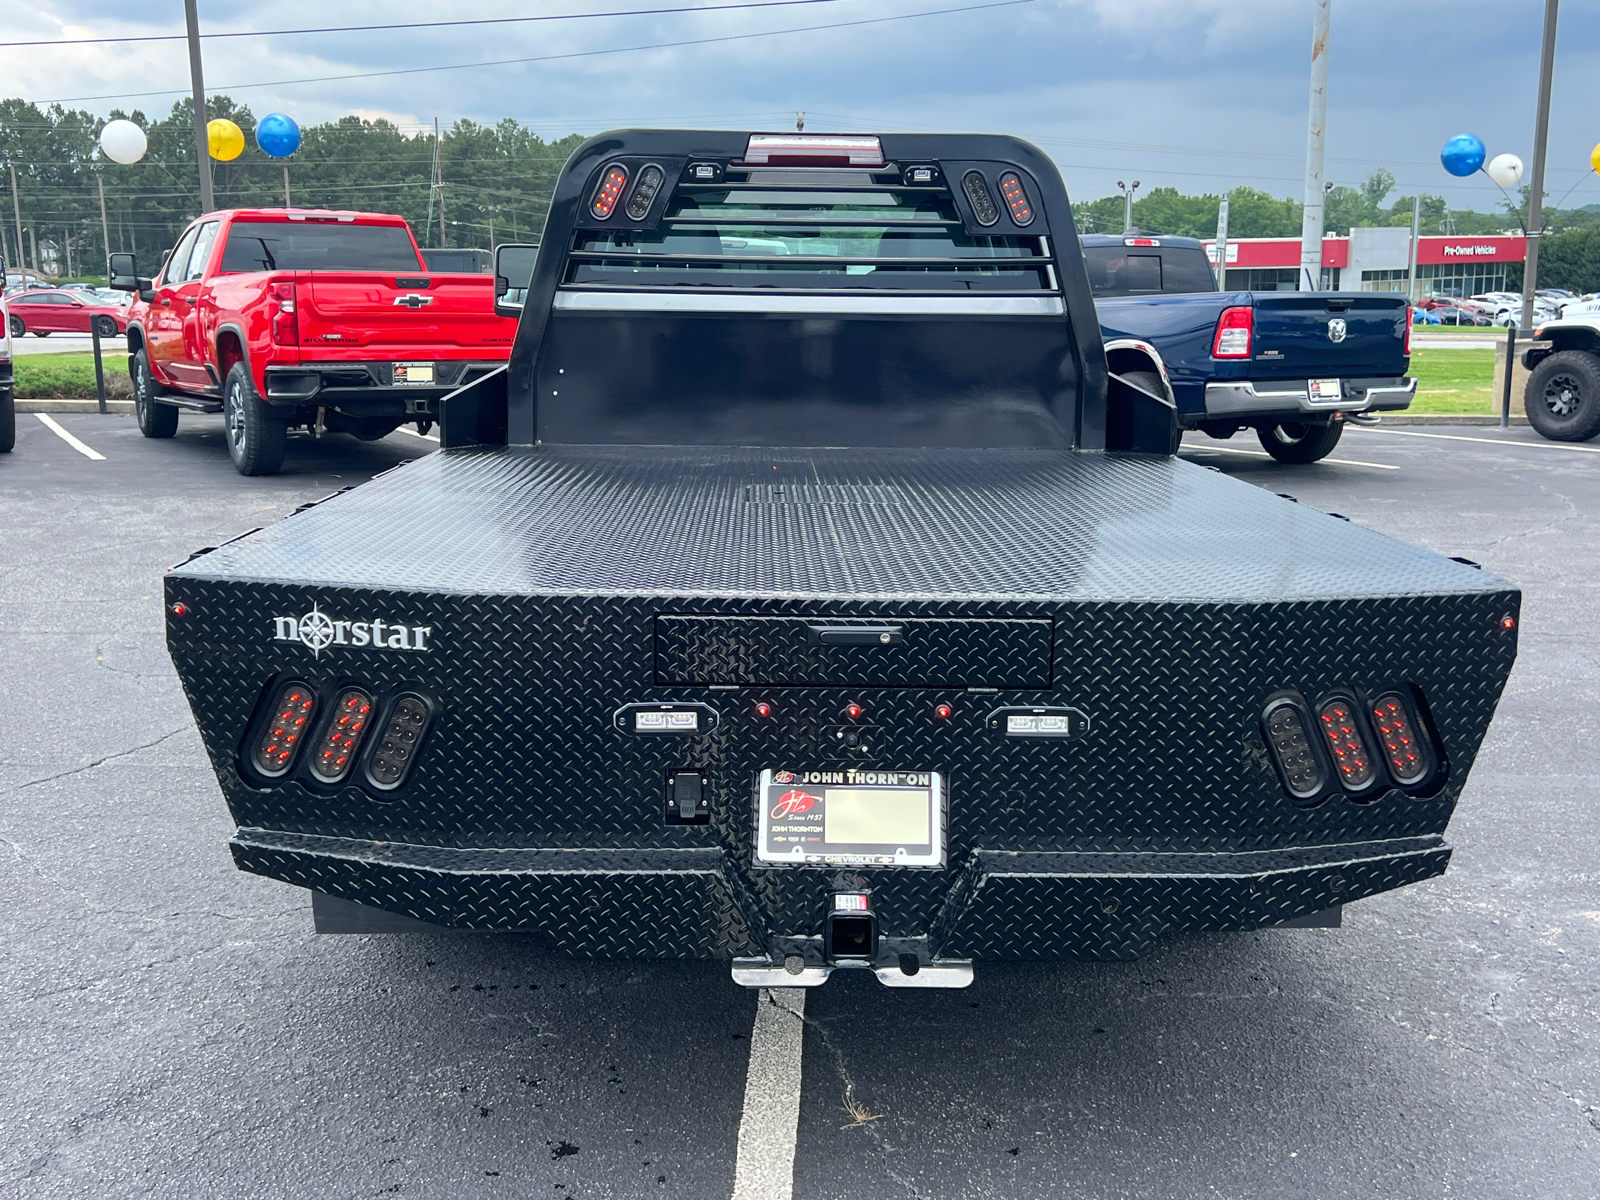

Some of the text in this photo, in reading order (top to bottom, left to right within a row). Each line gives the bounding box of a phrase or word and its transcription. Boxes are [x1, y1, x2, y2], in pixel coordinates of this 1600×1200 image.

[1444, 245, 1496, 256] Pre-Owned Vehicles
[273, 600, 432, 660] norstar
[803, 772, 843, 784] JOHN
[788, 825, 823, 833] THORNTON
